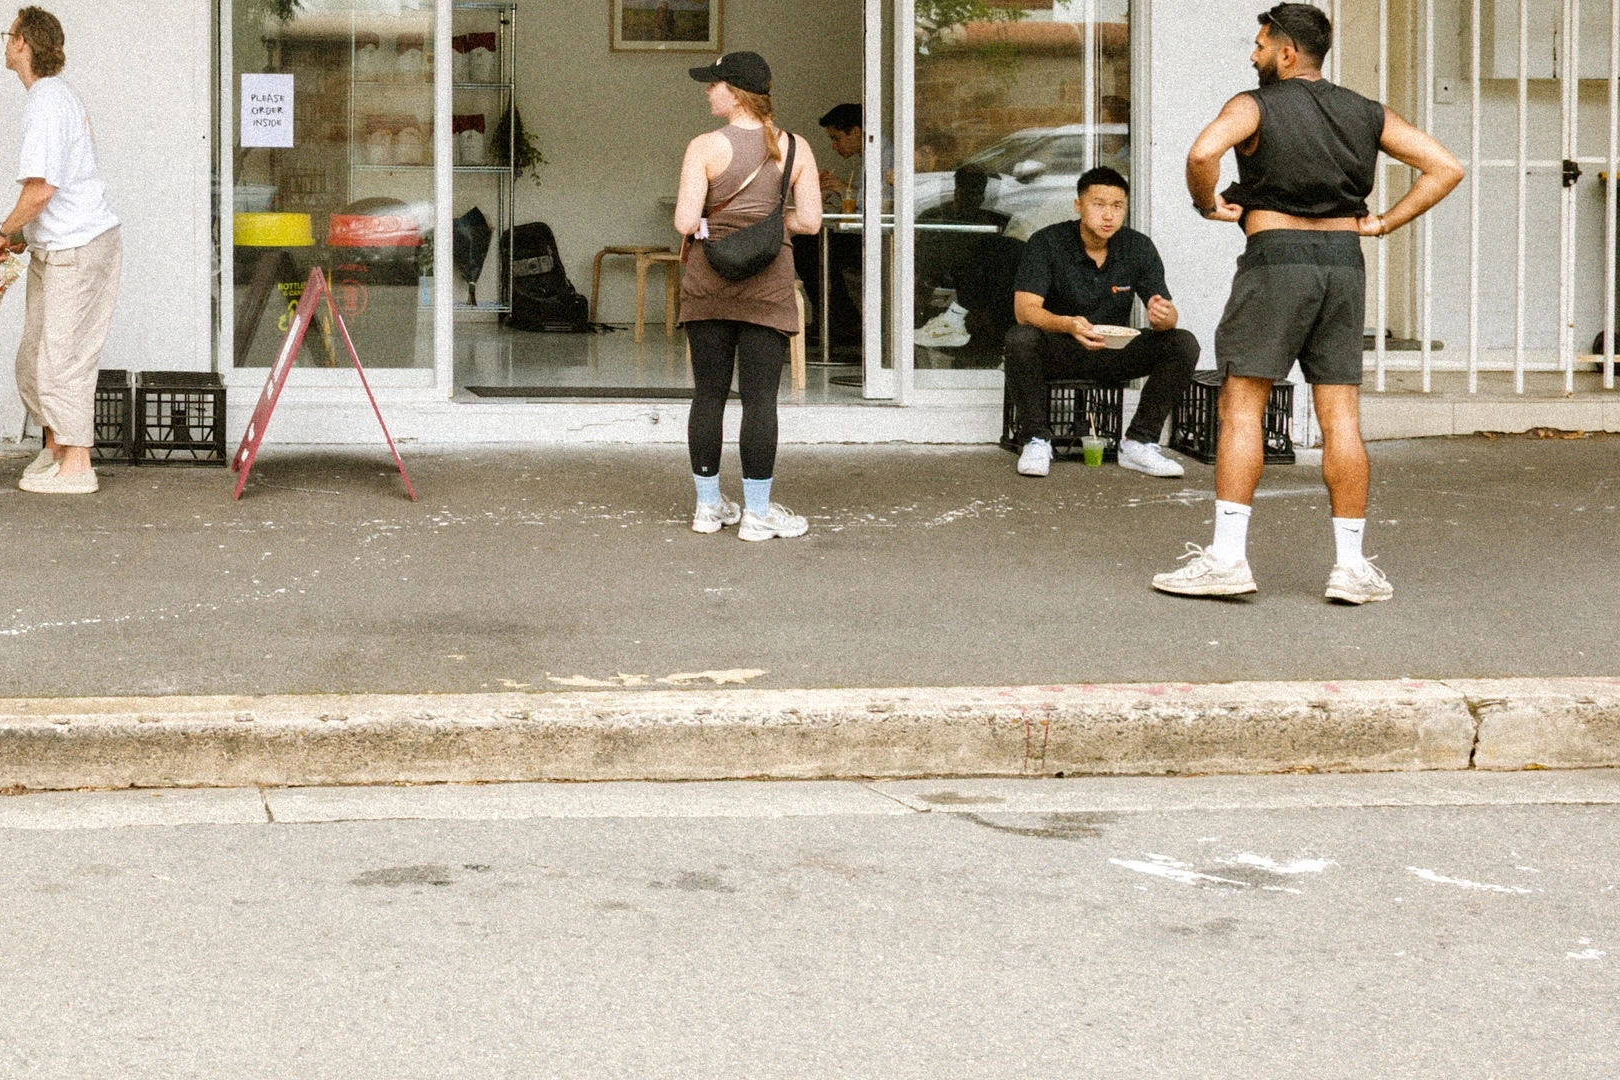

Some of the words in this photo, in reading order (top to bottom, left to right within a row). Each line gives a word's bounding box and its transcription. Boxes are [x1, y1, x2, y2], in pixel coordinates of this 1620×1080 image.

[251, 94, 285, 103] PLEASE
[251, 107, 284, 115] ORDER
[253, 119, 283, 127] INSIDE
[277, 282, 306, 290] BOTTLE
